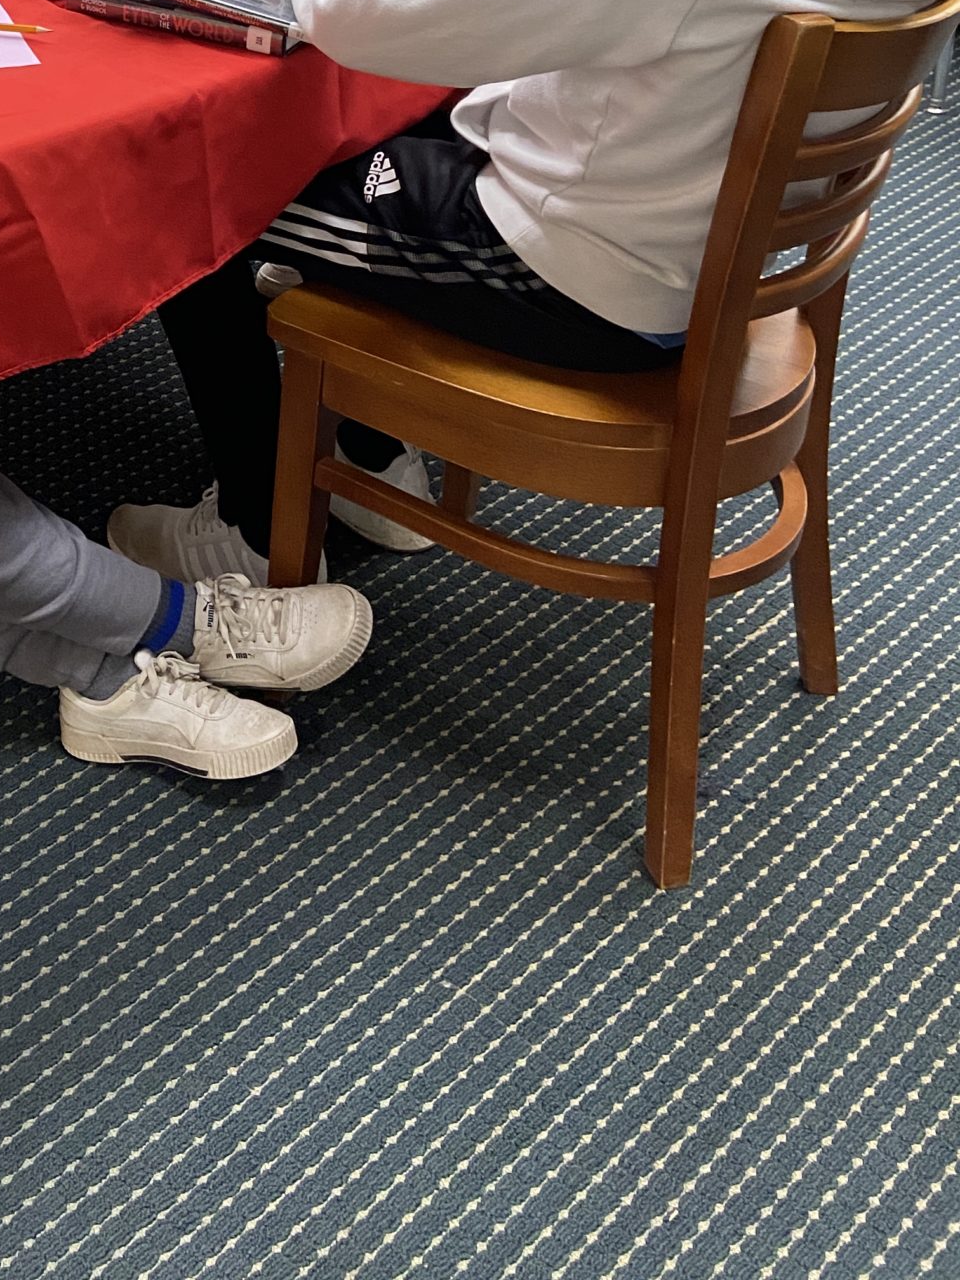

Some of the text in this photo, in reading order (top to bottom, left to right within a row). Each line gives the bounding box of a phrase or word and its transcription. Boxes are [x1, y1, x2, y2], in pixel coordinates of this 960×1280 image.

[122, 4, 158, 26] EYES
[159, 13, 171, 21] OF
[159, 20, 171, 30] THE
[172, 15, 236, 43] WORLD
[363, 151, 385, 204] adidas
[207, 604, 215, 628] PUMA
